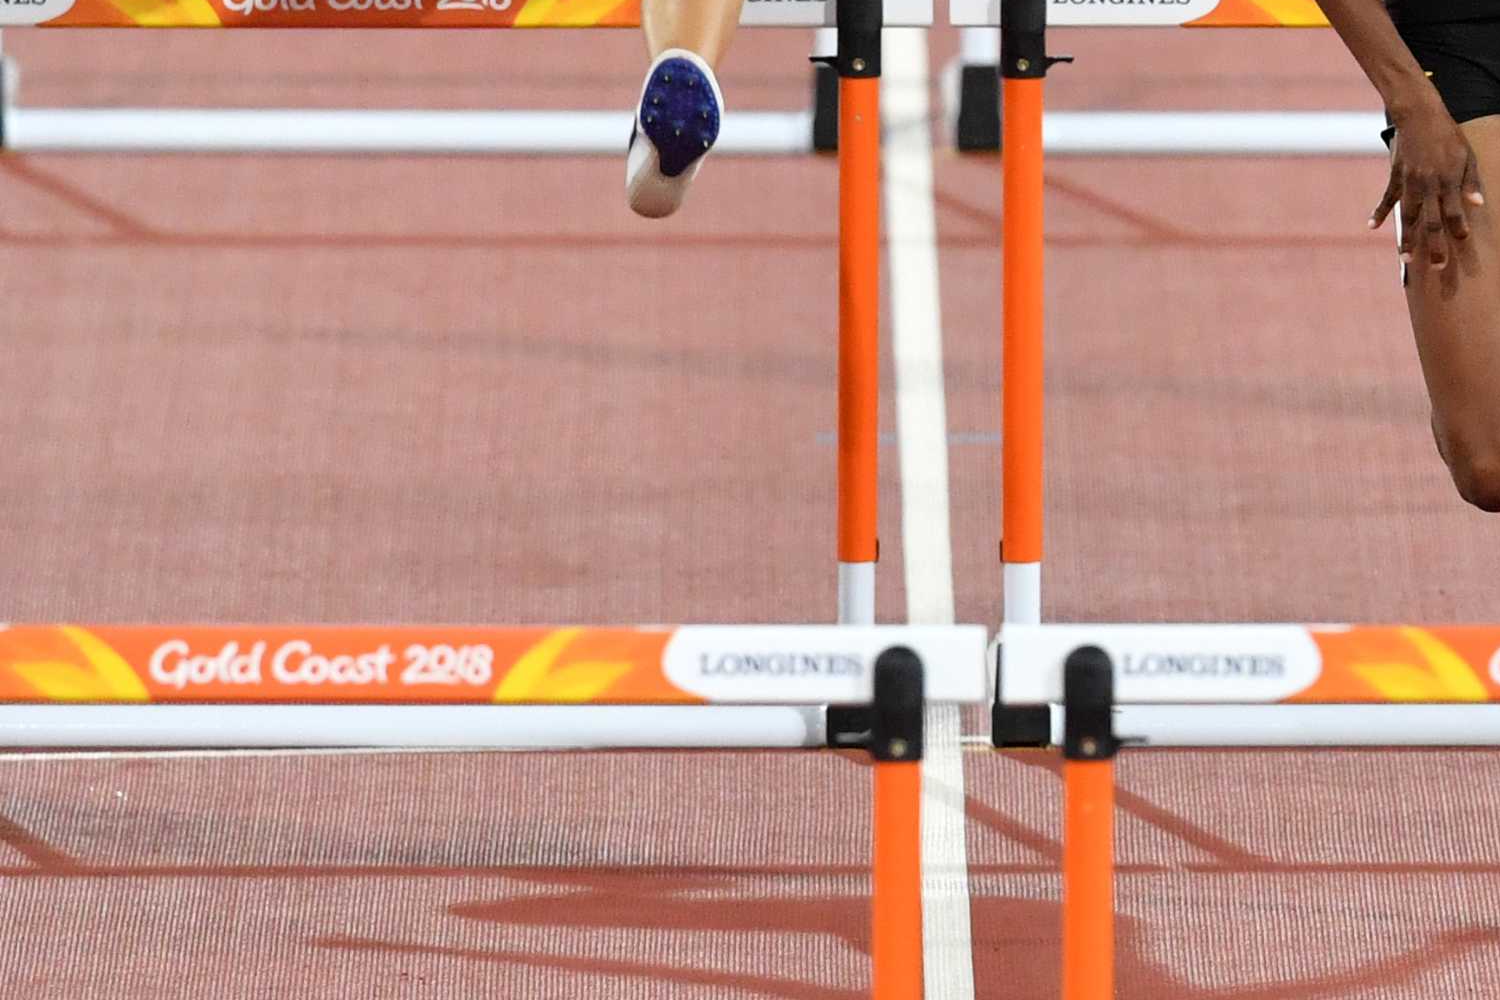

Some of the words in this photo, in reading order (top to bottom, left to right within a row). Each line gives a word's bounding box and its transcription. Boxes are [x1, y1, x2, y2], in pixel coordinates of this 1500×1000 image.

[149, 640, 266, 690] Gold
[271, 640, 395, 685] Coast
[401, 643, 494, 685] 2018
[700, 652, 866, 677] LONGINES
[1122, 652, 1285, 678] LONGINES
